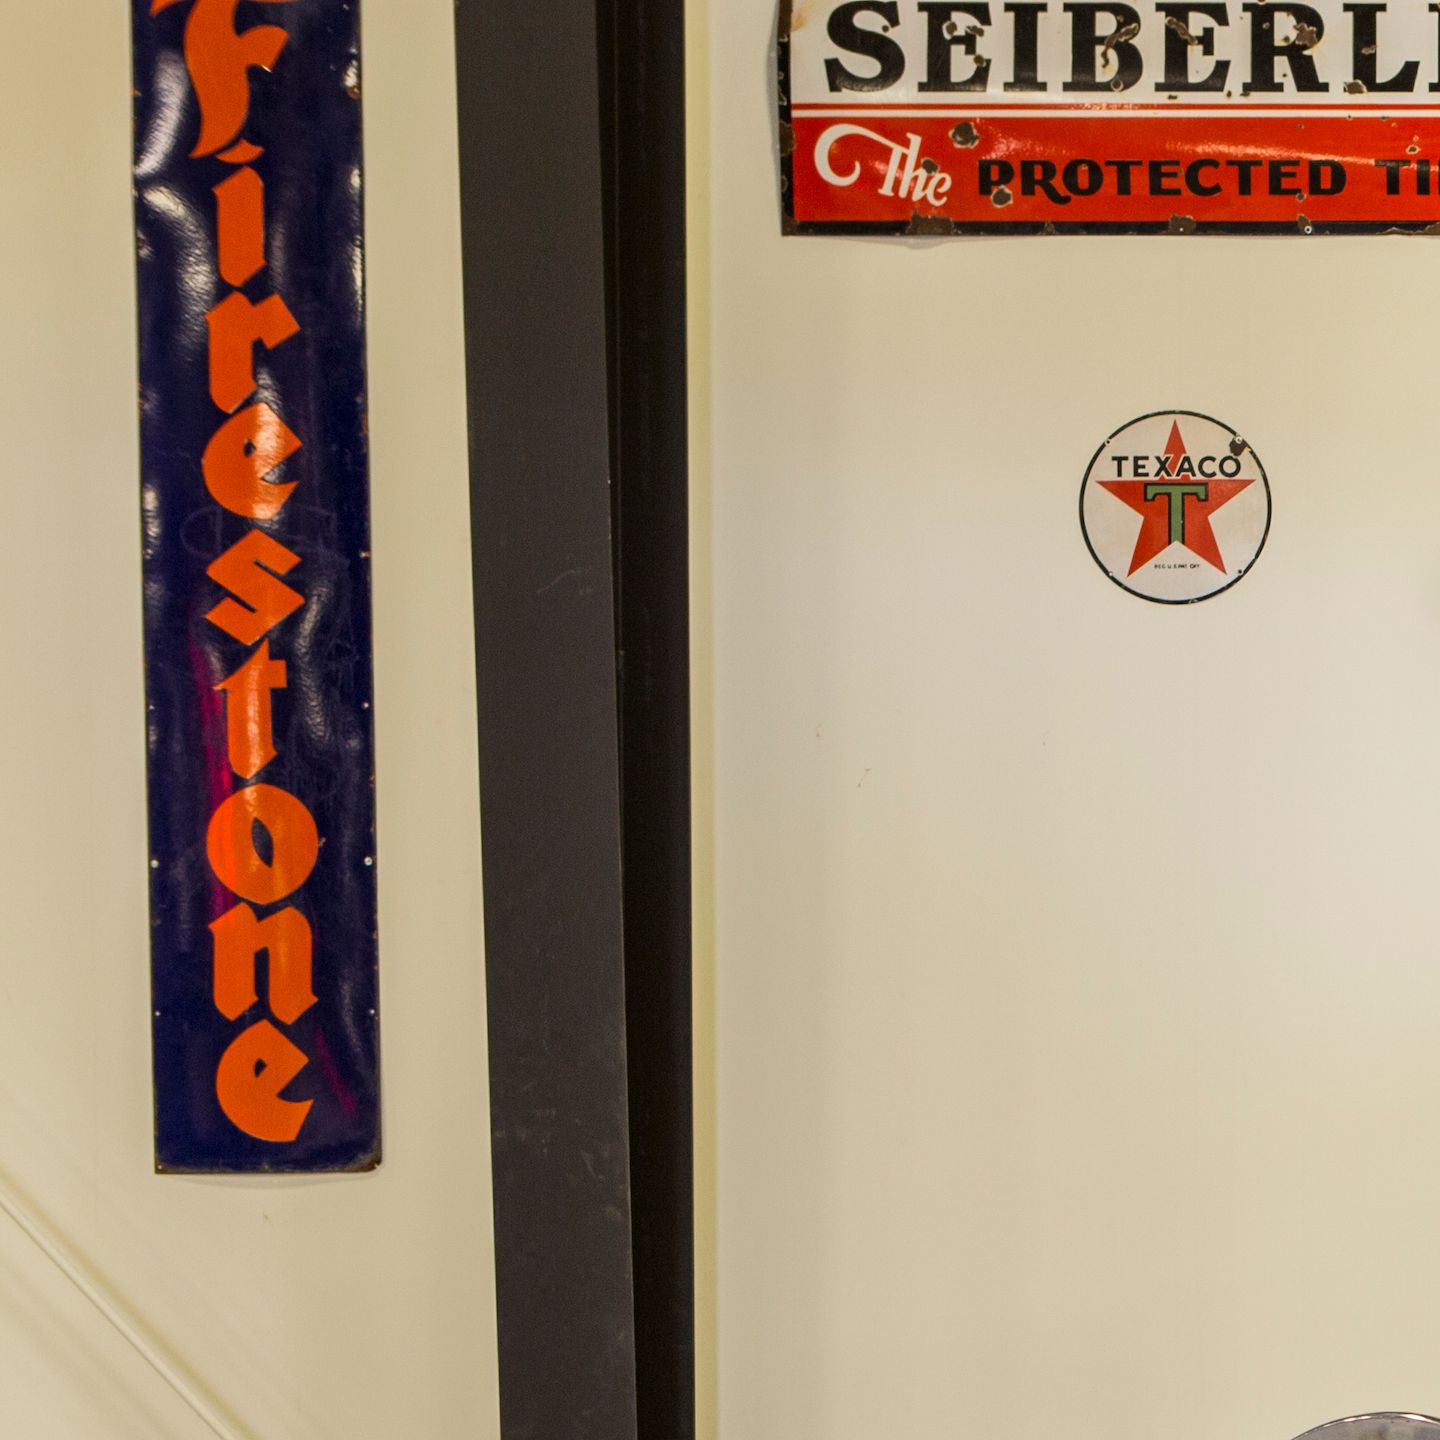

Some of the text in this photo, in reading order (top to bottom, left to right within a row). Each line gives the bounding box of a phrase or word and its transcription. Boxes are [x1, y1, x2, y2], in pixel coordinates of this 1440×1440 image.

[813, 123, 952, 206] The
[978, 159, 1347, 205] PROTECTED
[1111, 455, 1242, 479] TEXACO
[1143, 482, 1209, 546] T
[150, 0, 319, 1143] Firestone
